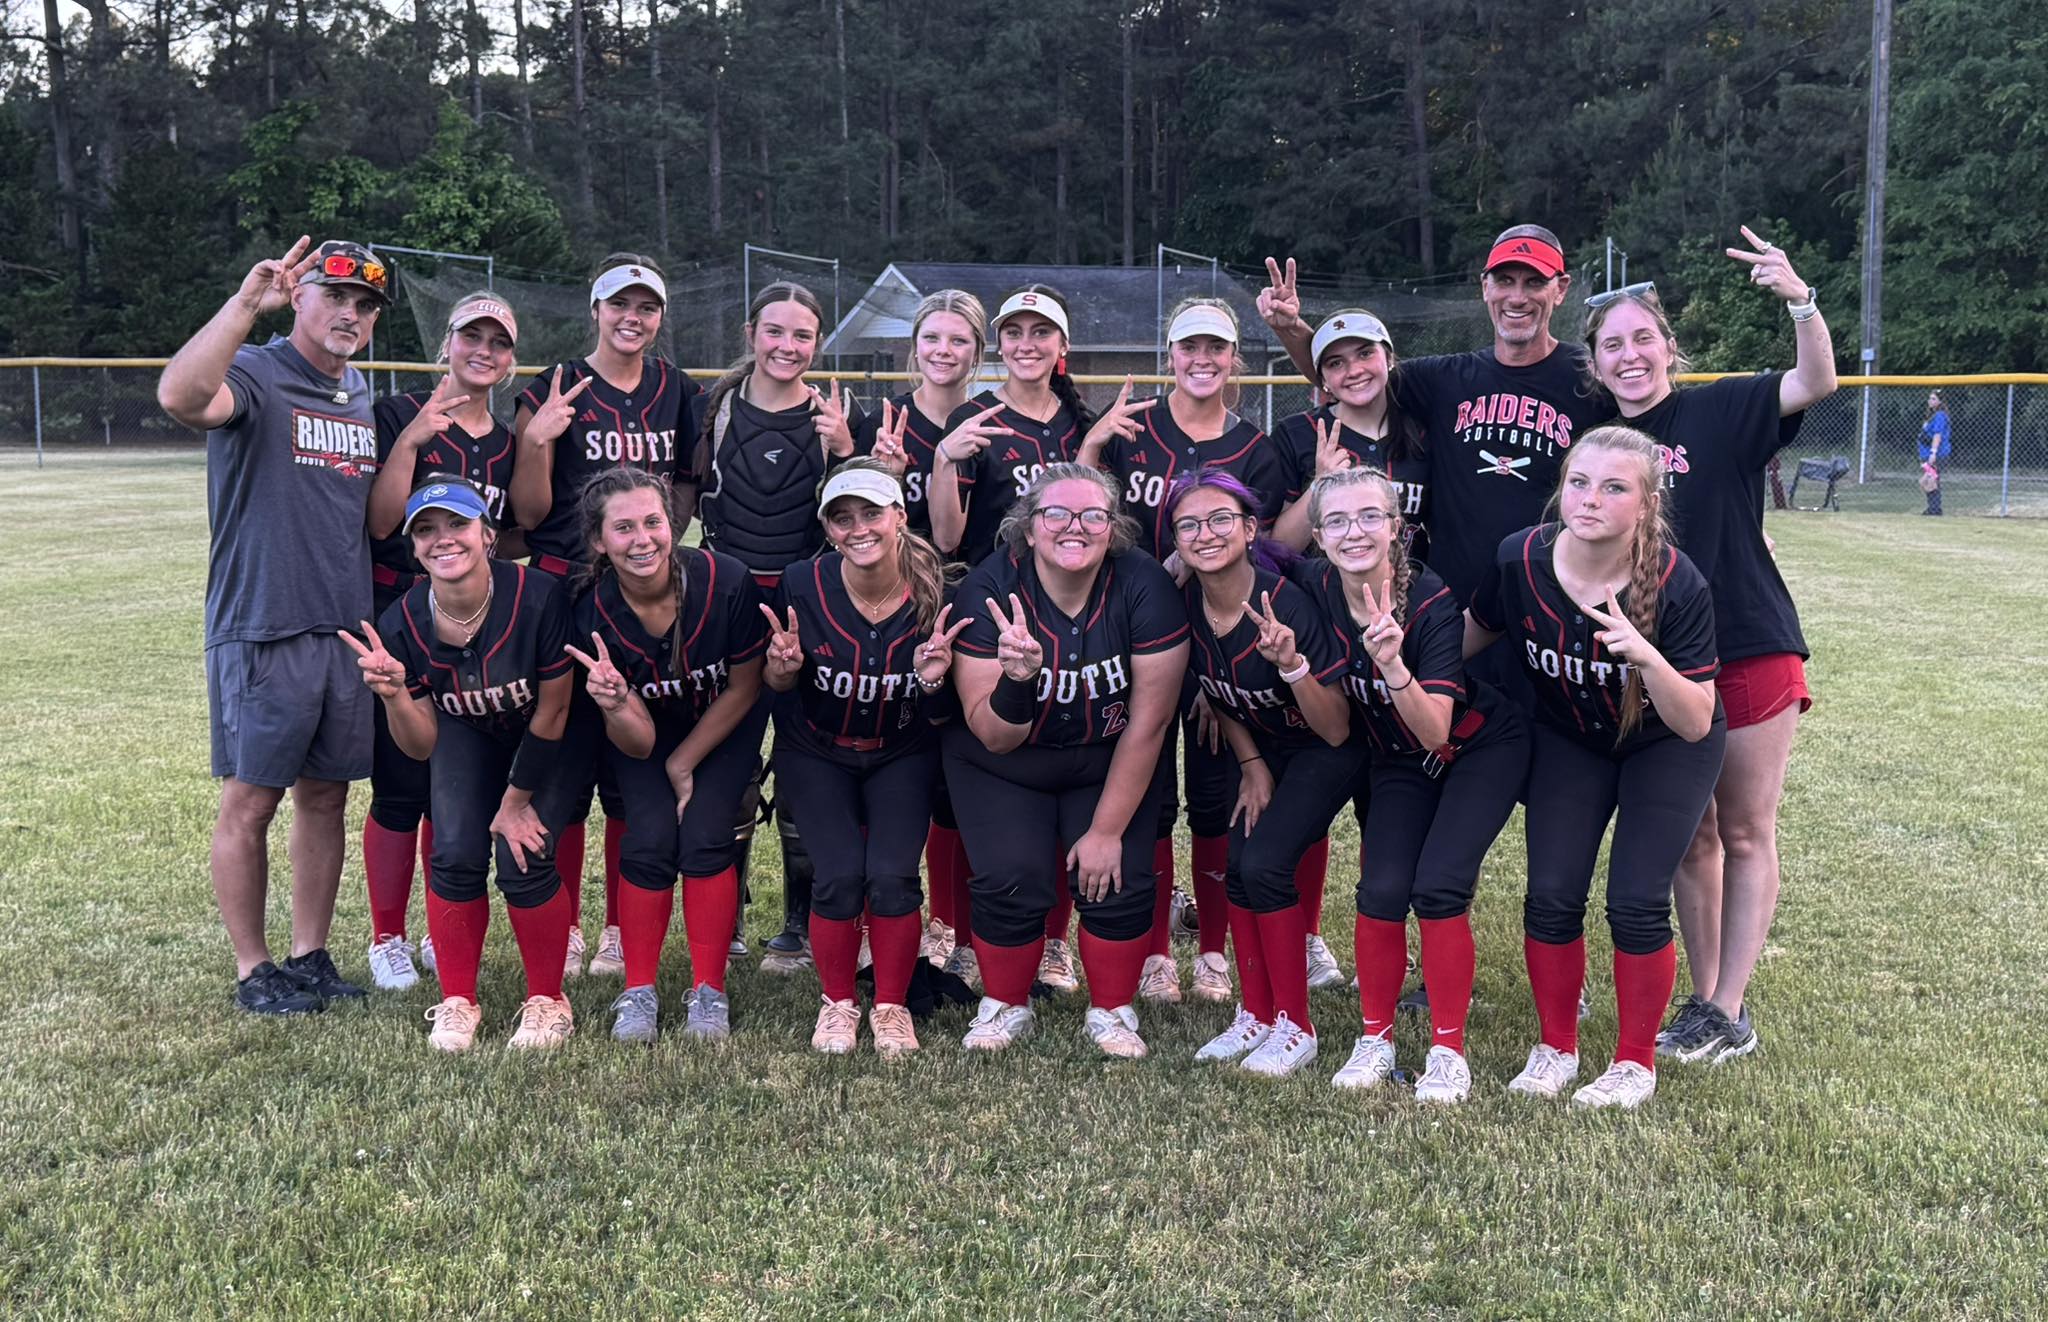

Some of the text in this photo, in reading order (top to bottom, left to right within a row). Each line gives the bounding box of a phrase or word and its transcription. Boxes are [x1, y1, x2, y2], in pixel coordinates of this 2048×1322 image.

[478, 303, 505, 318] ELITE
[297, 415, 376, 459] RAIDERS
[1454, 393, 1573, 449] RAIDERS
[585, 429, 676, 462] SOUTH
[1463, 426, 1553, 457] SOFTBALL
[1036, 655, 1129, 704] OUTH
